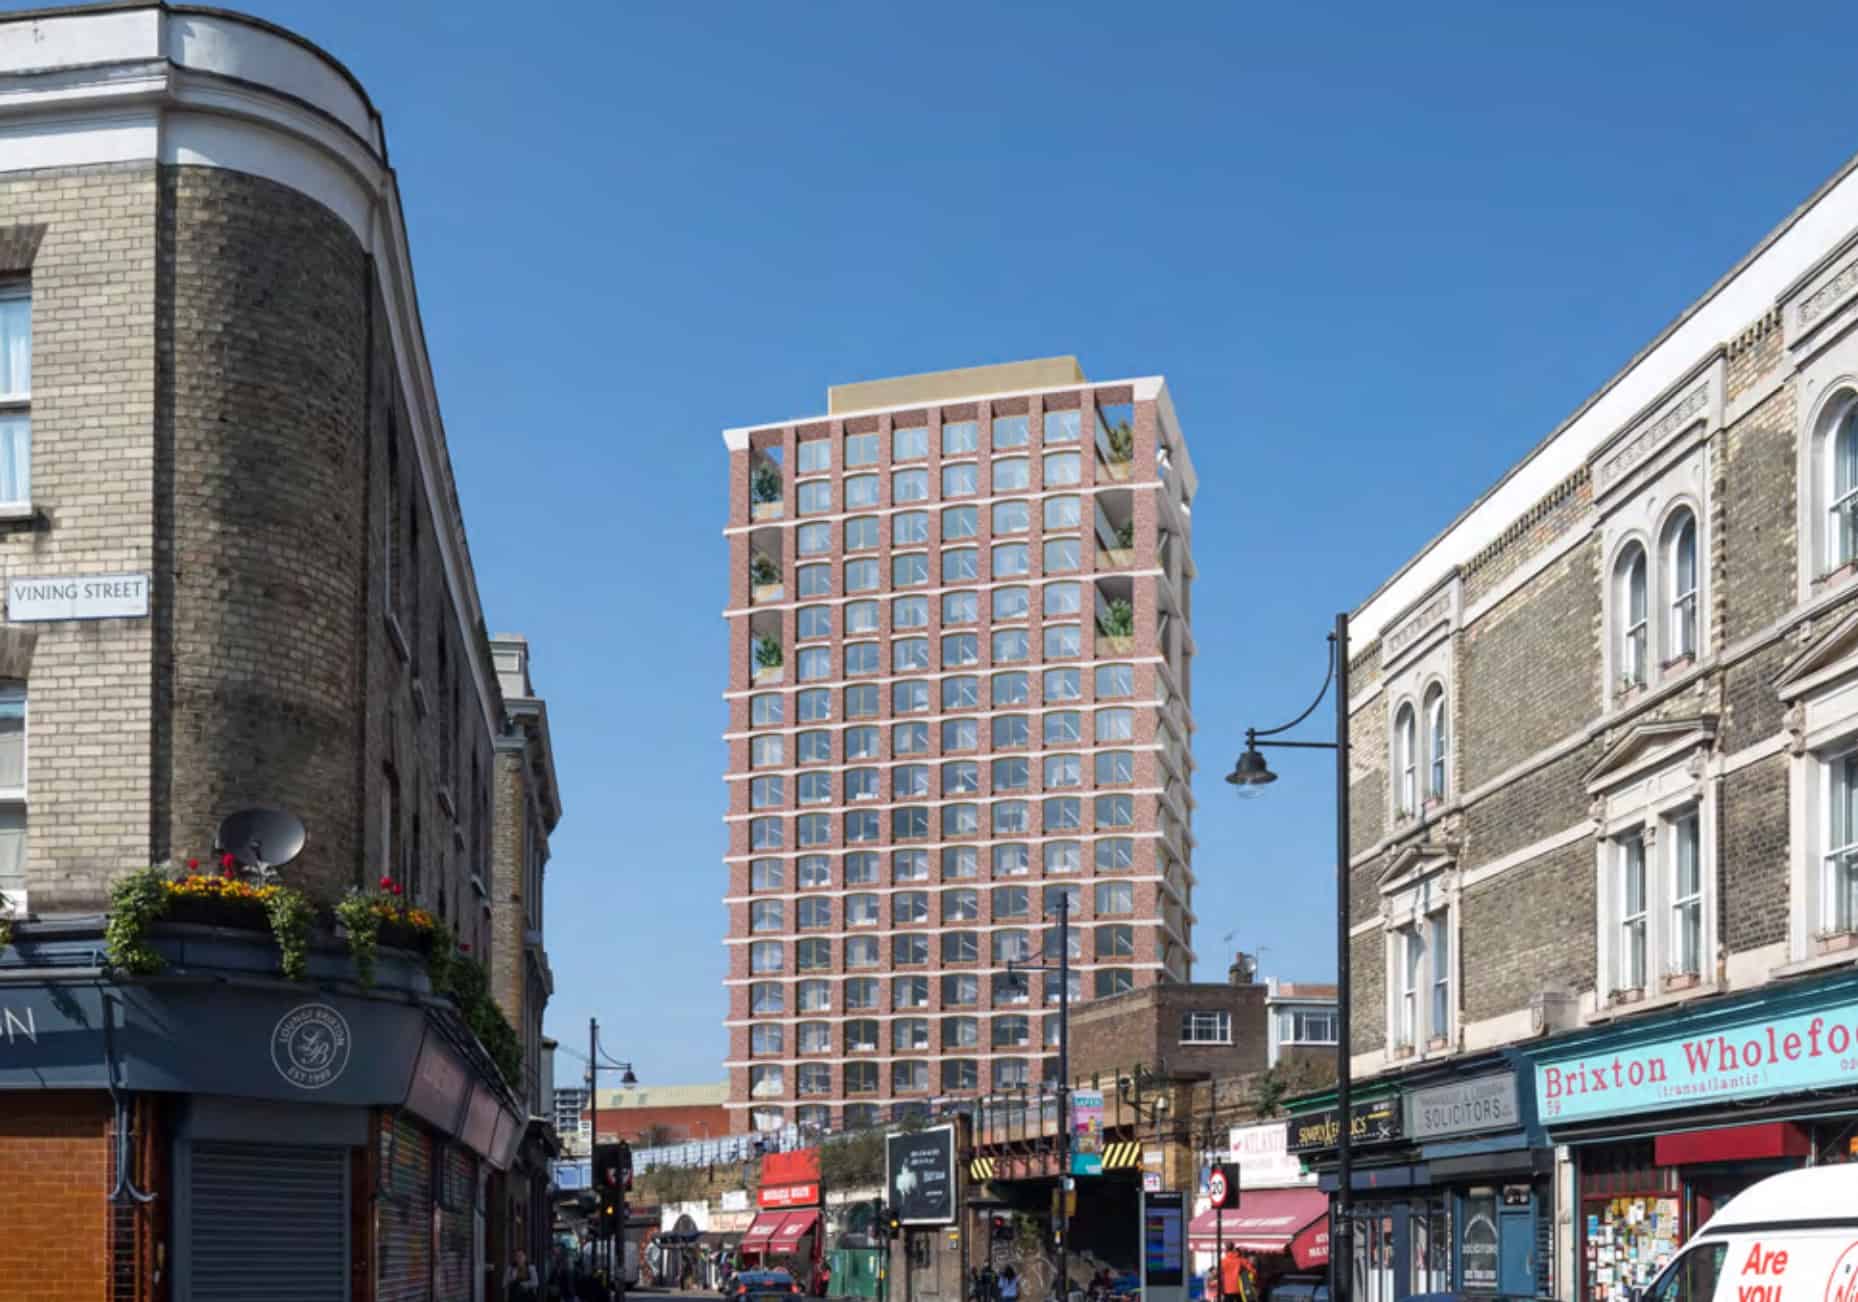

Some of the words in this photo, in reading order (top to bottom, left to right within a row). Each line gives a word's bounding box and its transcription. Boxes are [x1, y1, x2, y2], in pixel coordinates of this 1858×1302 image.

[15, 583, 78, 601] VINING
[84, 581, 142, 599] STREET
[0, 1007, 37, 1045] N
[1545, 1055, 1667, 1099] Brixton
[1682, 1016, 1858, 1077] Wholefo
[1424, 1098, 1501, 1129] SOLICITORS
[1242, 1129, 1287, 1153] ATLANTI
[1212, 1180, 1224, 1196] 20
[1741, 1242, 1789, 1275] Are
[1738, 1284, 1783, 1302] you
